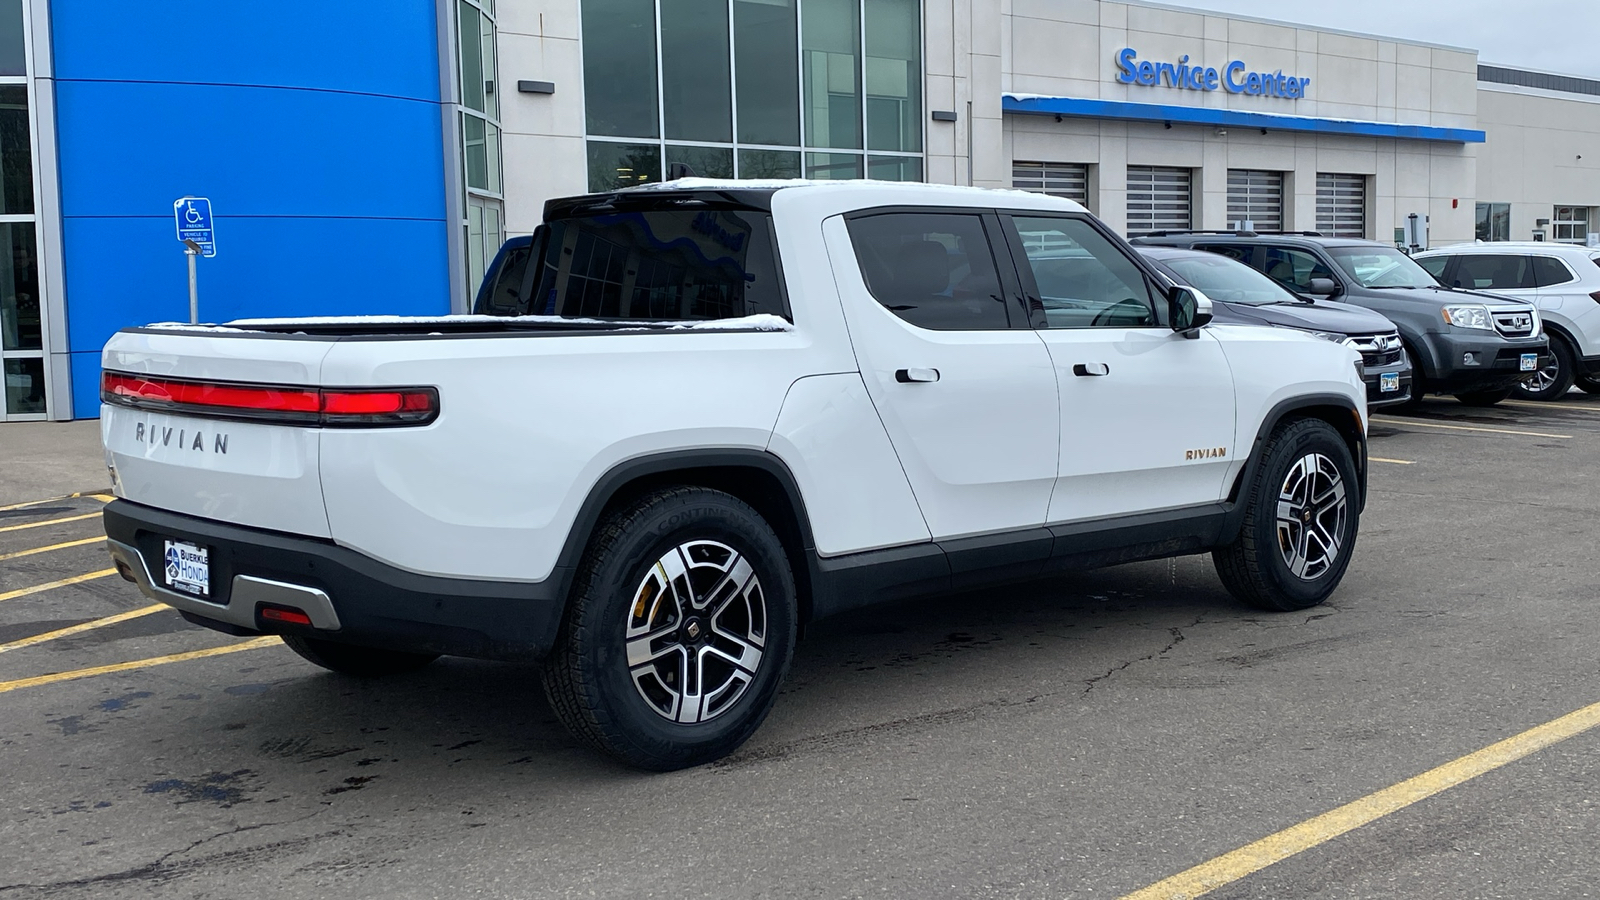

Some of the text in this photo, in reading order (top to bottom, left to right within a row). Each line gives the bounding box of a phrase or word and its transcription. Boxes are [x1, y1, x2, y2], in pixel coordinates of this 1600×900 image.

[1115, 48, 1310, 99] Service Center
[136, 422, 228, 454] RIVIAN
[1186, 447, 1226, 460] RIVIAN
[180, 549, 208, 566] BUERKLE
[181, 561, 208, 582] HONDA
